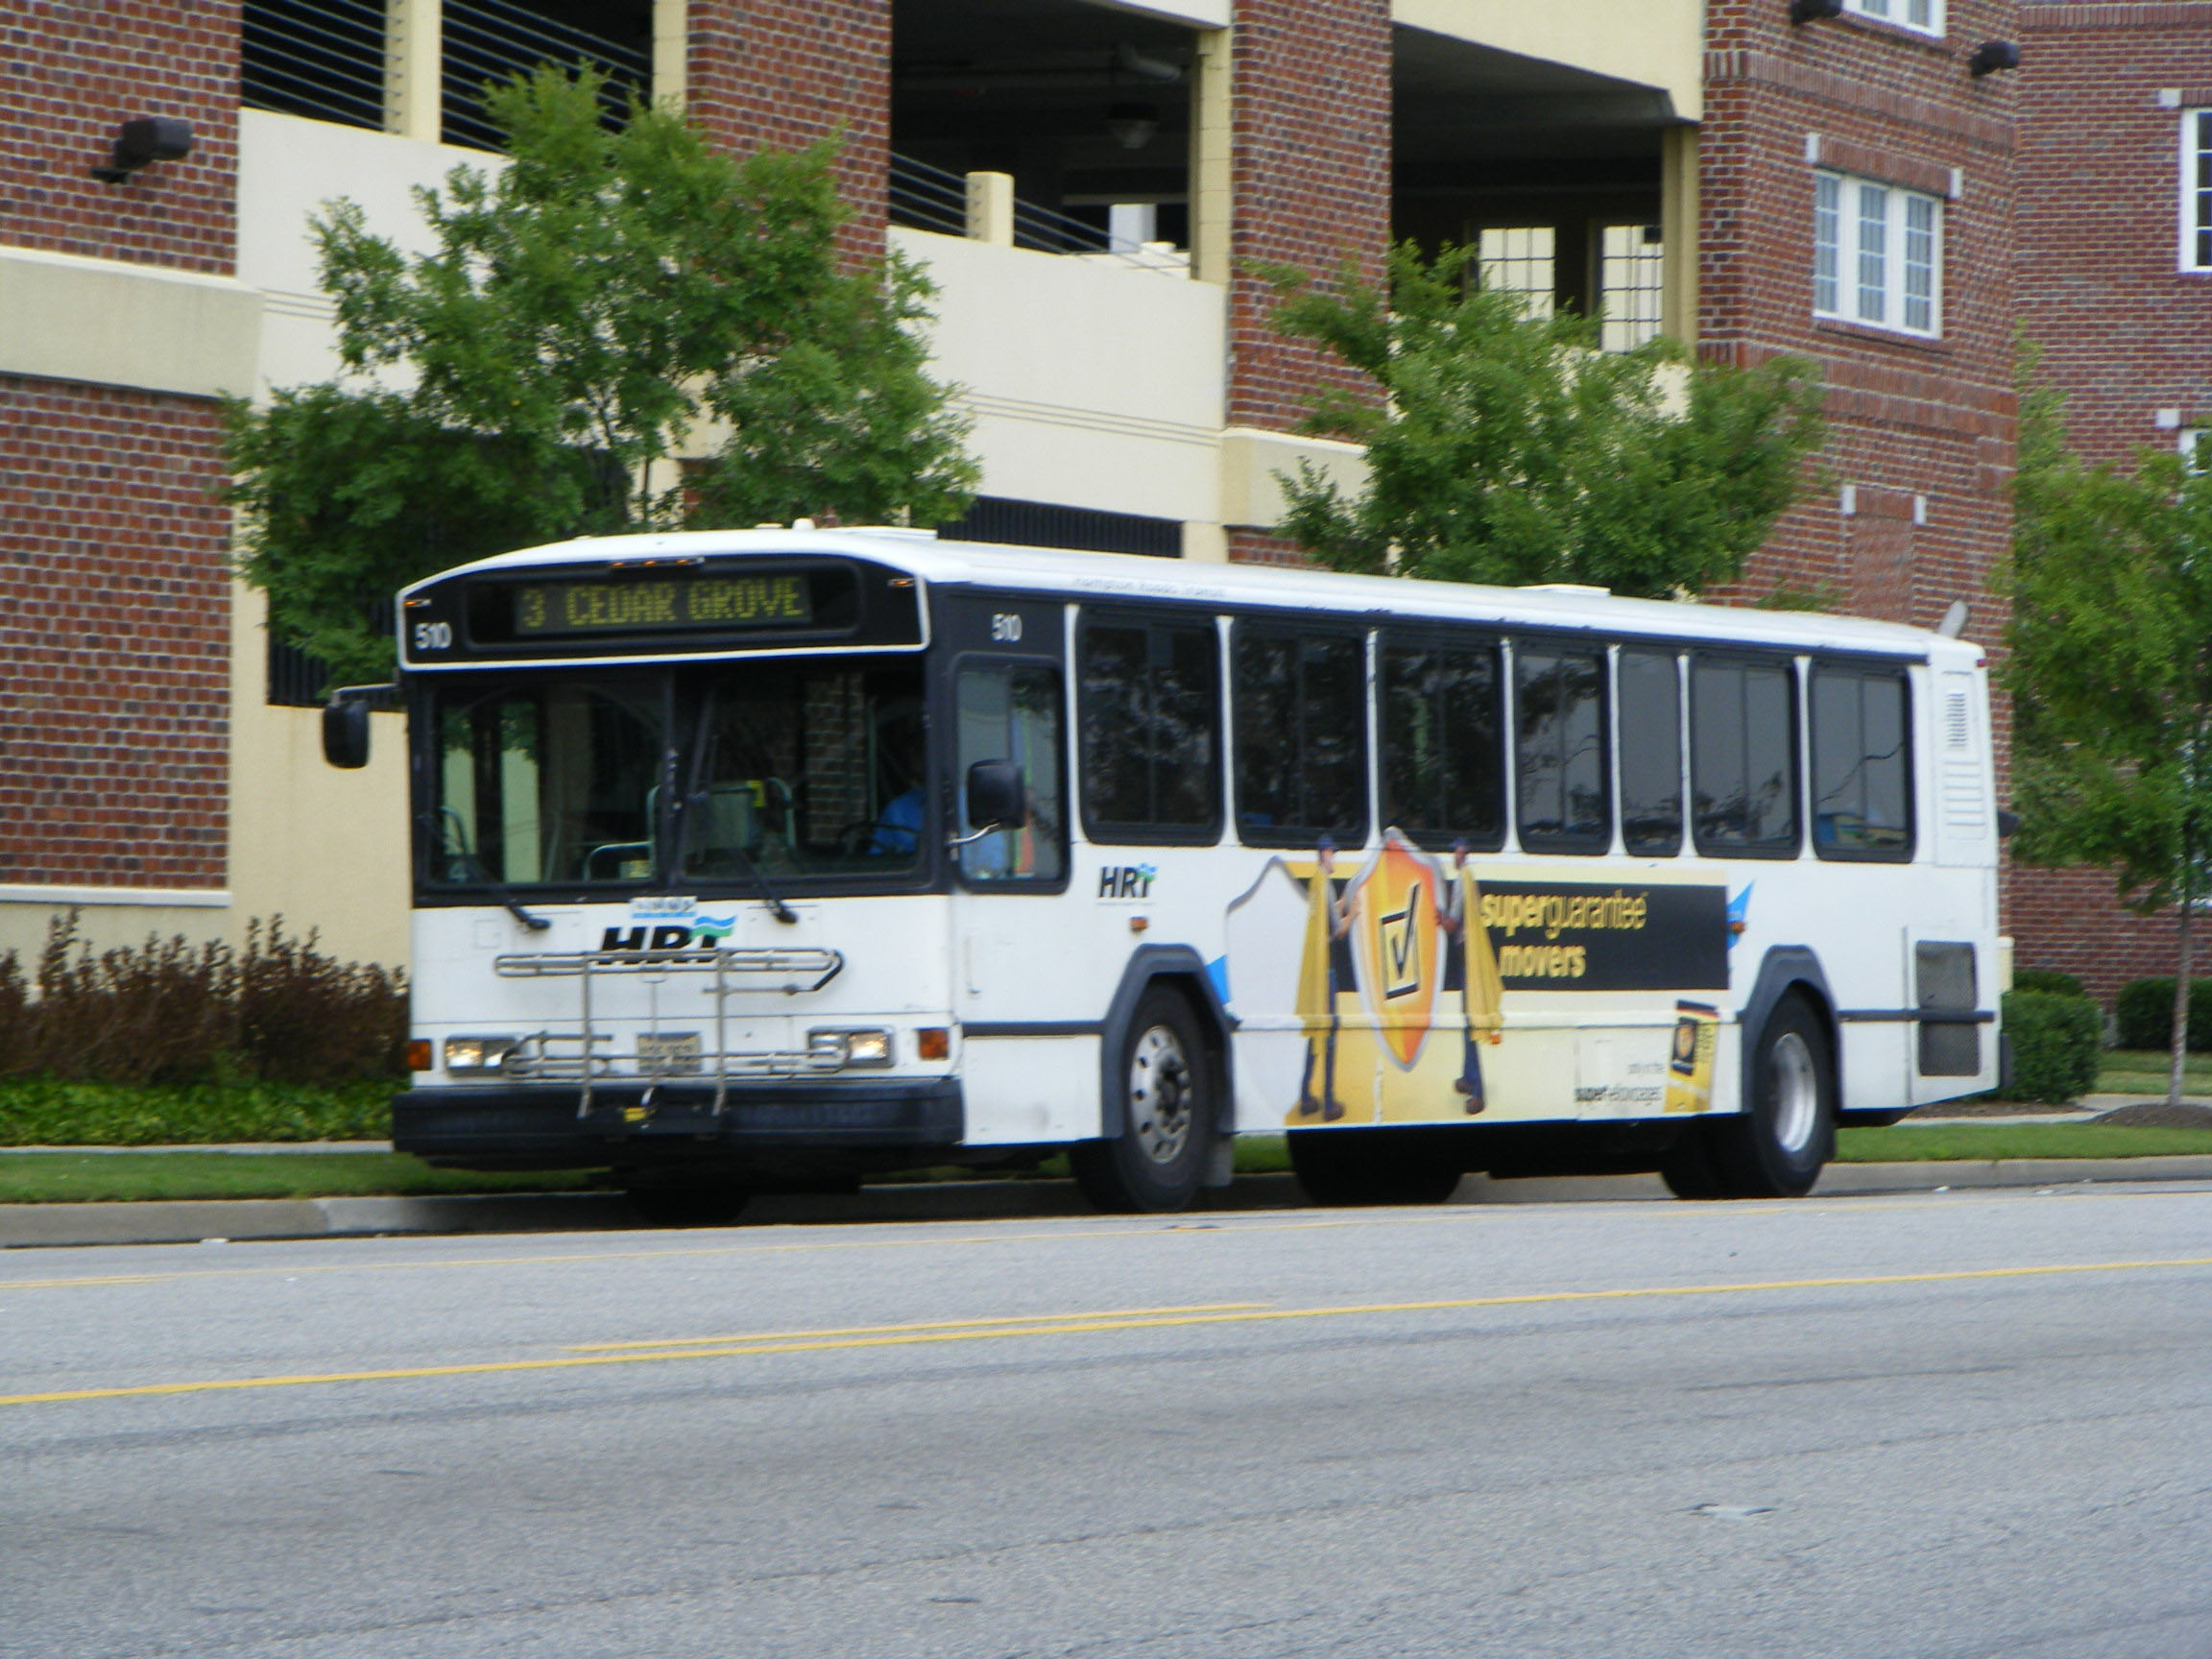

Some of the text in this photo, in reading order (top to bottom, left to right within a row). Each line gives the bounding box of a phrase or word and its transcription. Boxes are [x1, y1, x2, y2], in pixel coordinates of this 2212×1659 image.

[523, 577, 803, 626] 3 CEDAR GROVE
[415, 621, 452, 650] 510
[992, 613, 1022, 642] 510
[1098, 864, 1155, 898] HRT
[1499, 945, 1587, 977] movers
